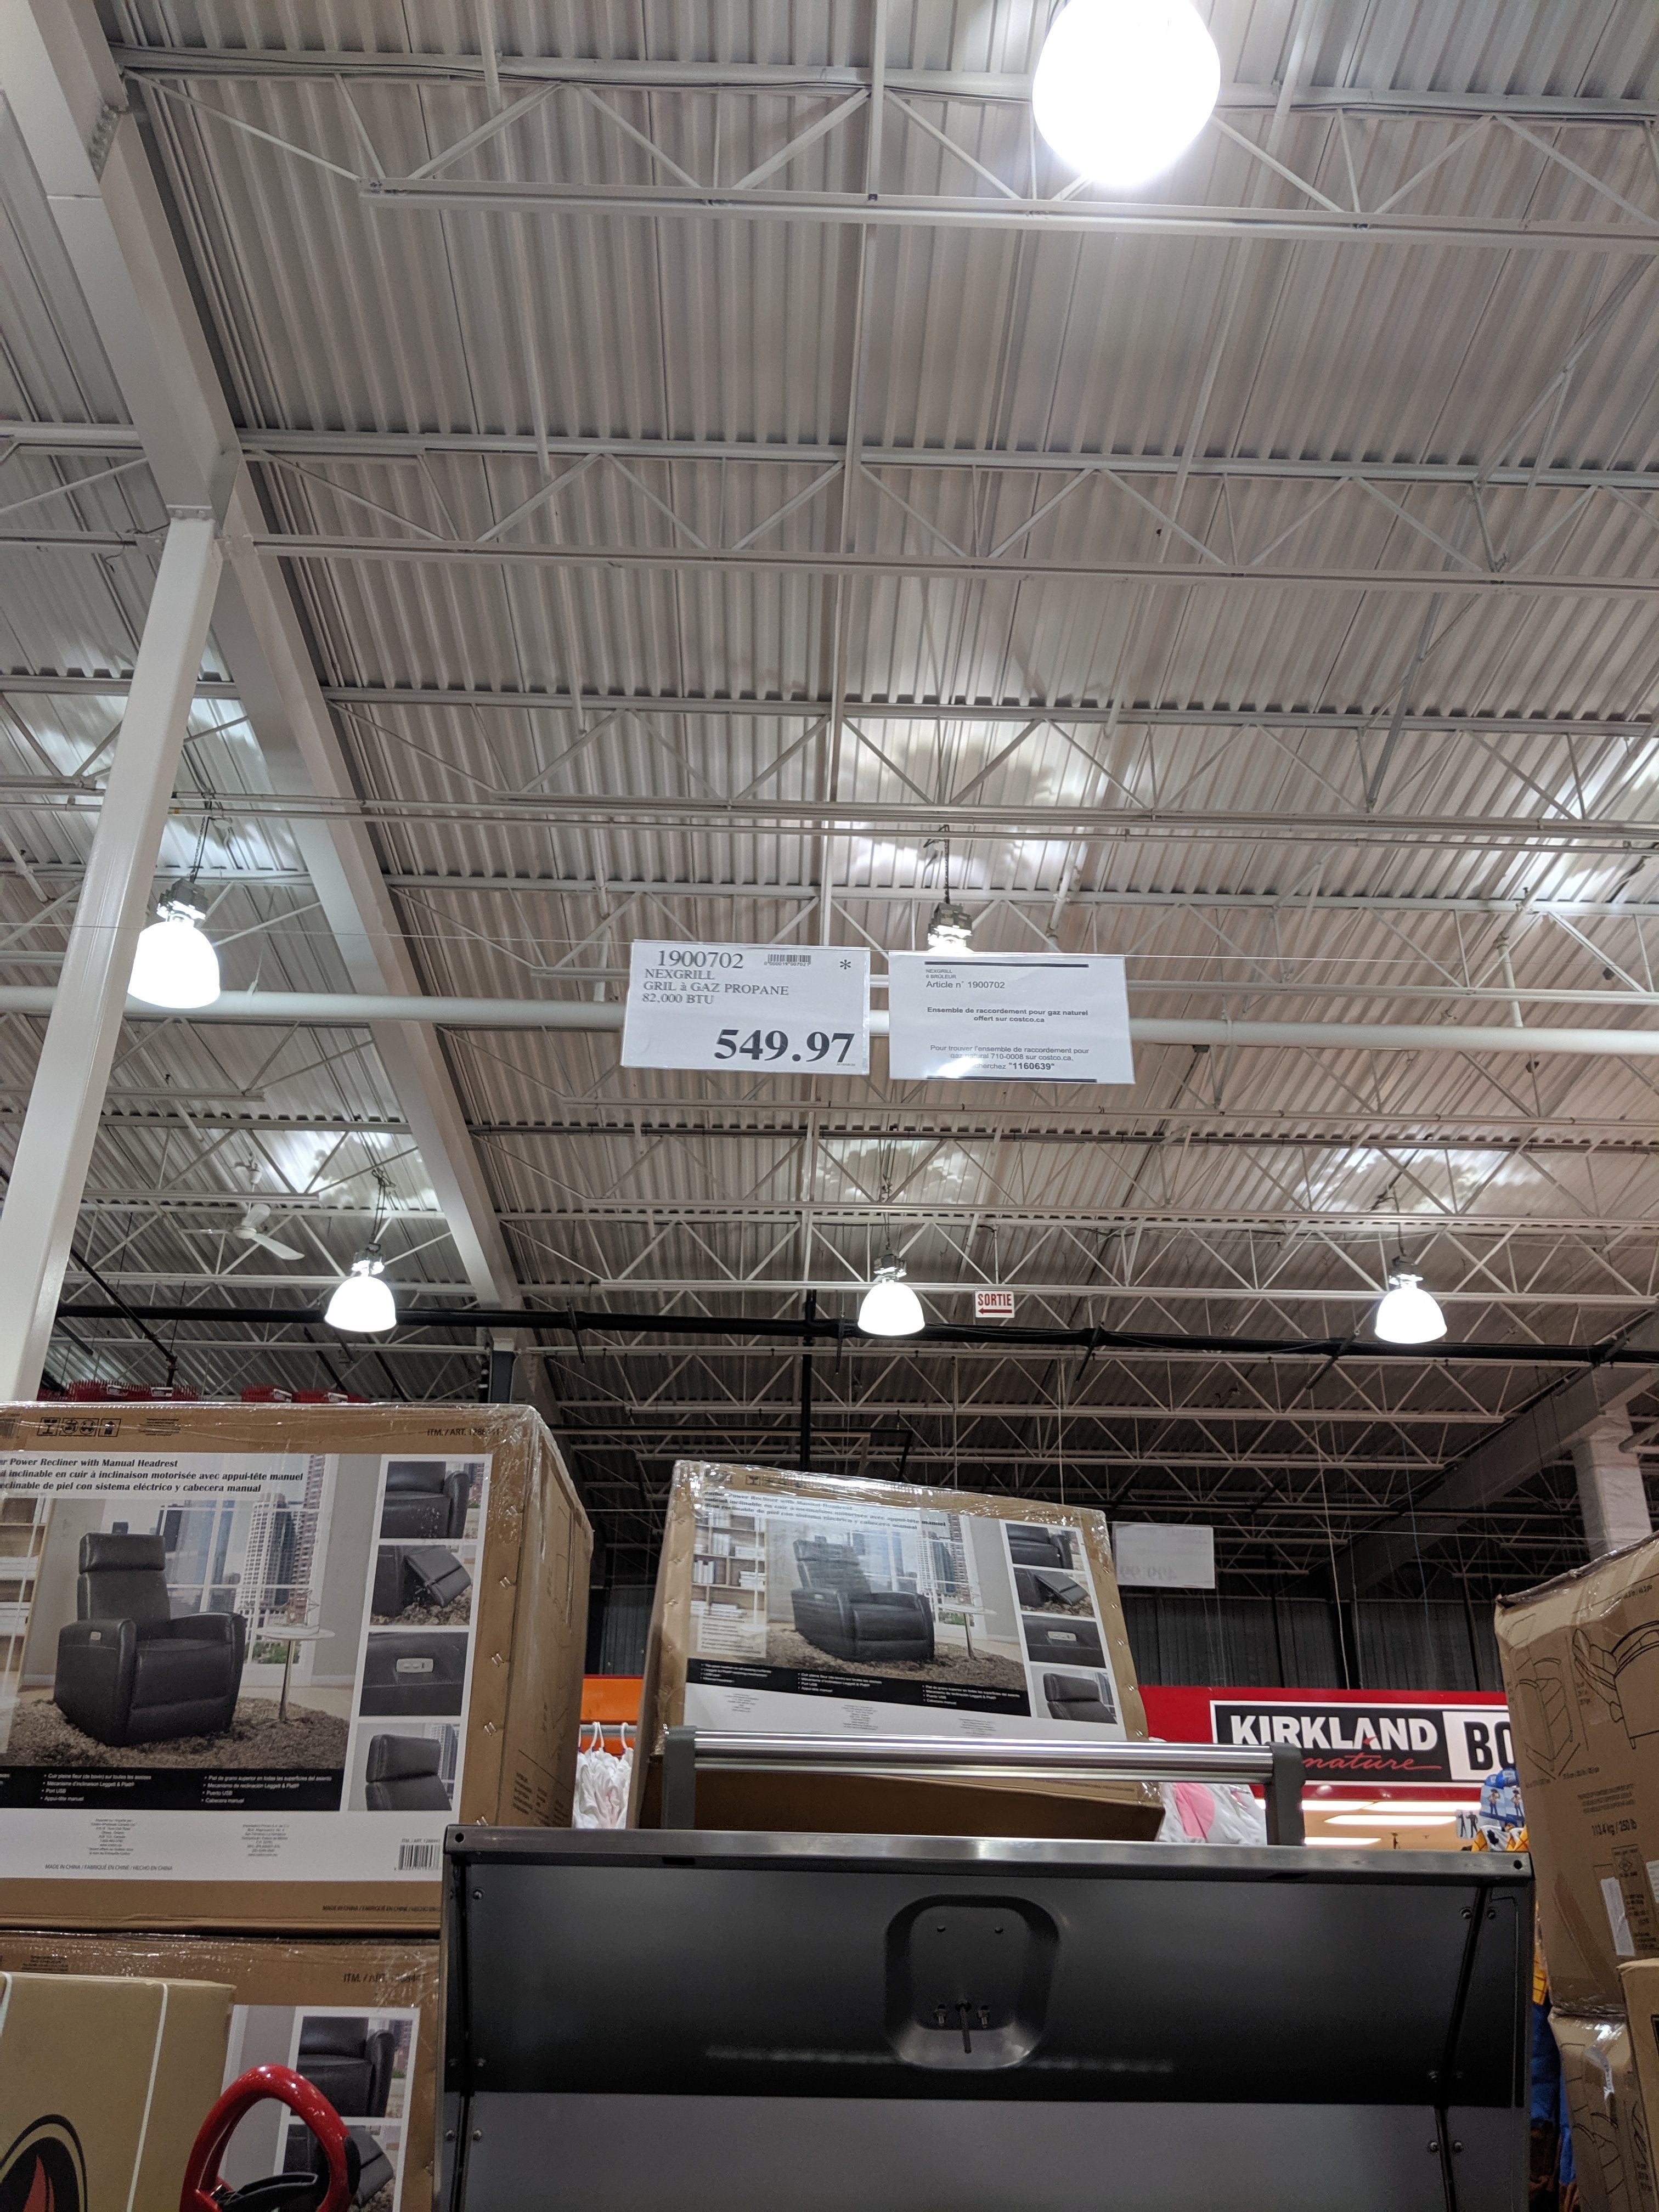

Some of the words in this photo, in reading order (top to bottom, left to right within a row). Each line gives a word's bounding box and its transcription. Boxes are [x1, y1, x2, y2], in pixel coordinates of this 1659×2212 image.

[658, 950, 744, 969] 1900702
[645, 968, 715, 980] NEXGRILL
[644, 981, 676, 991] GRIL
[680, 981, 687, 991] à
[690, 982, 720, 992] GAZ
[724, 983, 789, 995] PROPANE
[642, 993, 682, 1003] 82,000
[687, 994, 714, 1004] BTU
[714, 1029, 855, 1063] 549.97
[978, 1294, 1012, 1306] SORTIE
[450, 1427, 466, 1436] ART.
[10, 1458, 40, 1466] Power
[41, 1458, 78, 1466] Recliner
[101, 1459, 134, 1467] Manual
[69, 1470, 88, 1478] cuir
[91, 1470, 95, 1478] à
[99, 1470, 148, 1479] inclinaison
[151, 1471, 196, 1479] motorisée
[222, 1472, 267, 1481] appui-tête
[56, 1482, 74, 1491] piel
[133, 1483, 172, 1491] eléctrico
[1230, 1715, 1438, 1751] KIRKLAND
[1304, 1752, 1442, 1770] nature
